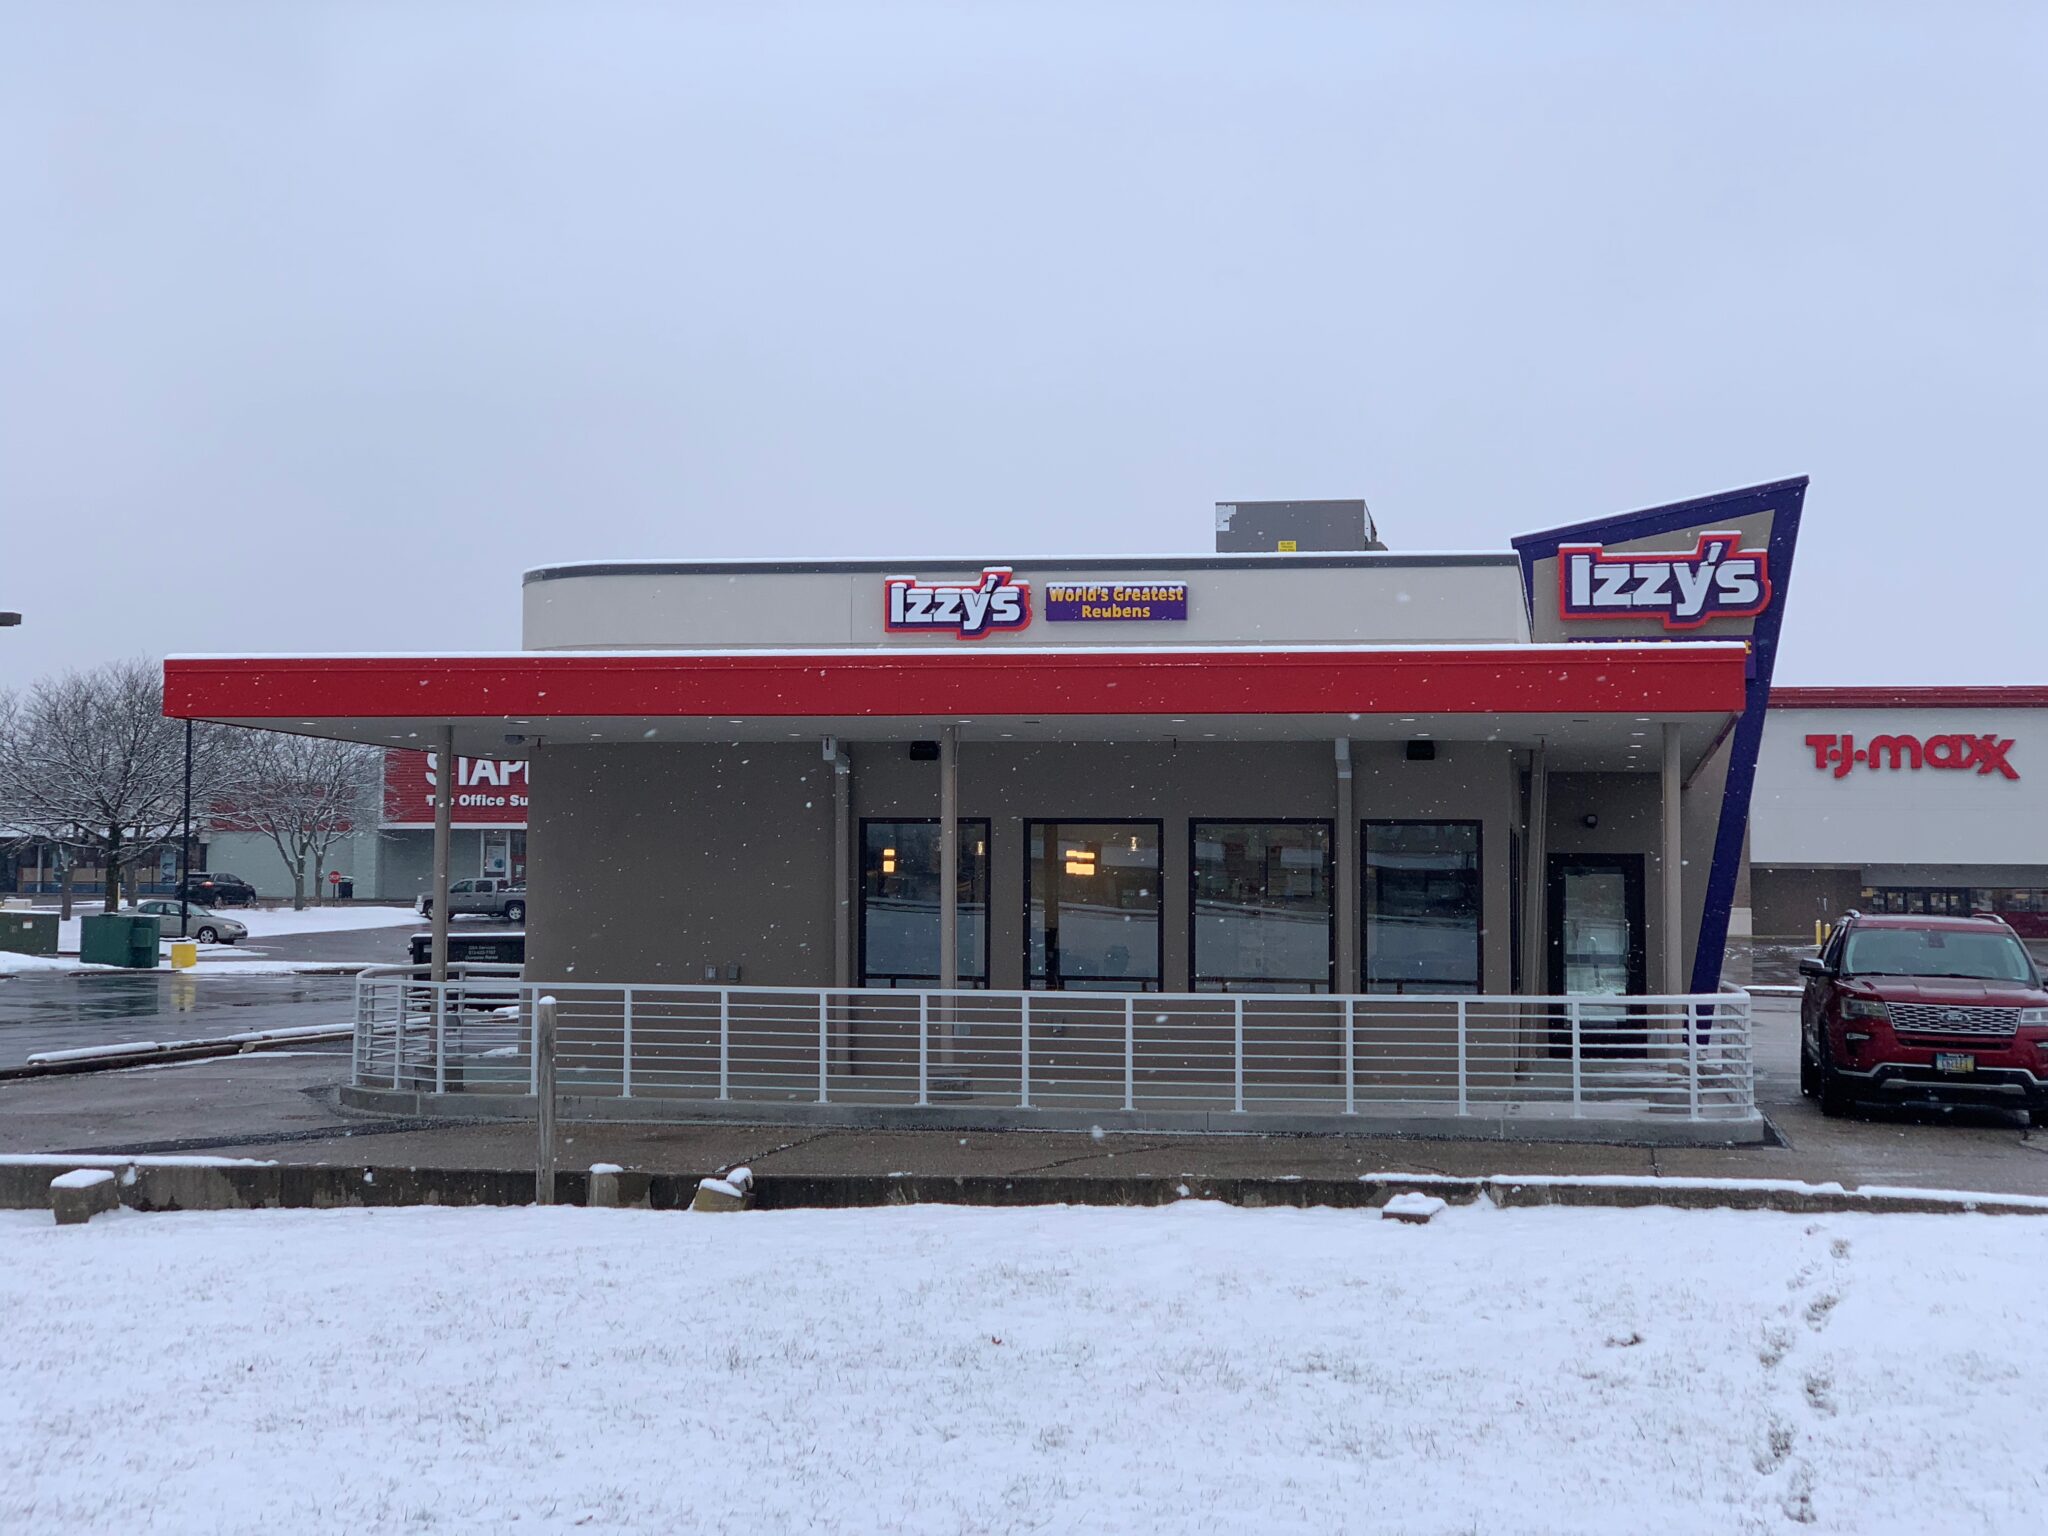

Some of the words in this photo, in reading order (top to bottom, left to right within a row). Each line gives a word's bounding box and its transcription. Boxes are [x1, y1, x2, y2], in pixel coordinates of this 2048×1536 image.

[1571, 542, 1760, 616] Izzy's
[890, 573, 1021, 631] Izzy's
[1048, 586, 1109, 602] World's
[1113, 586, 1184, 602] Greatest
[1081, 603, 1152, 618] Reubens
[458, 794, 505, 807] Office
